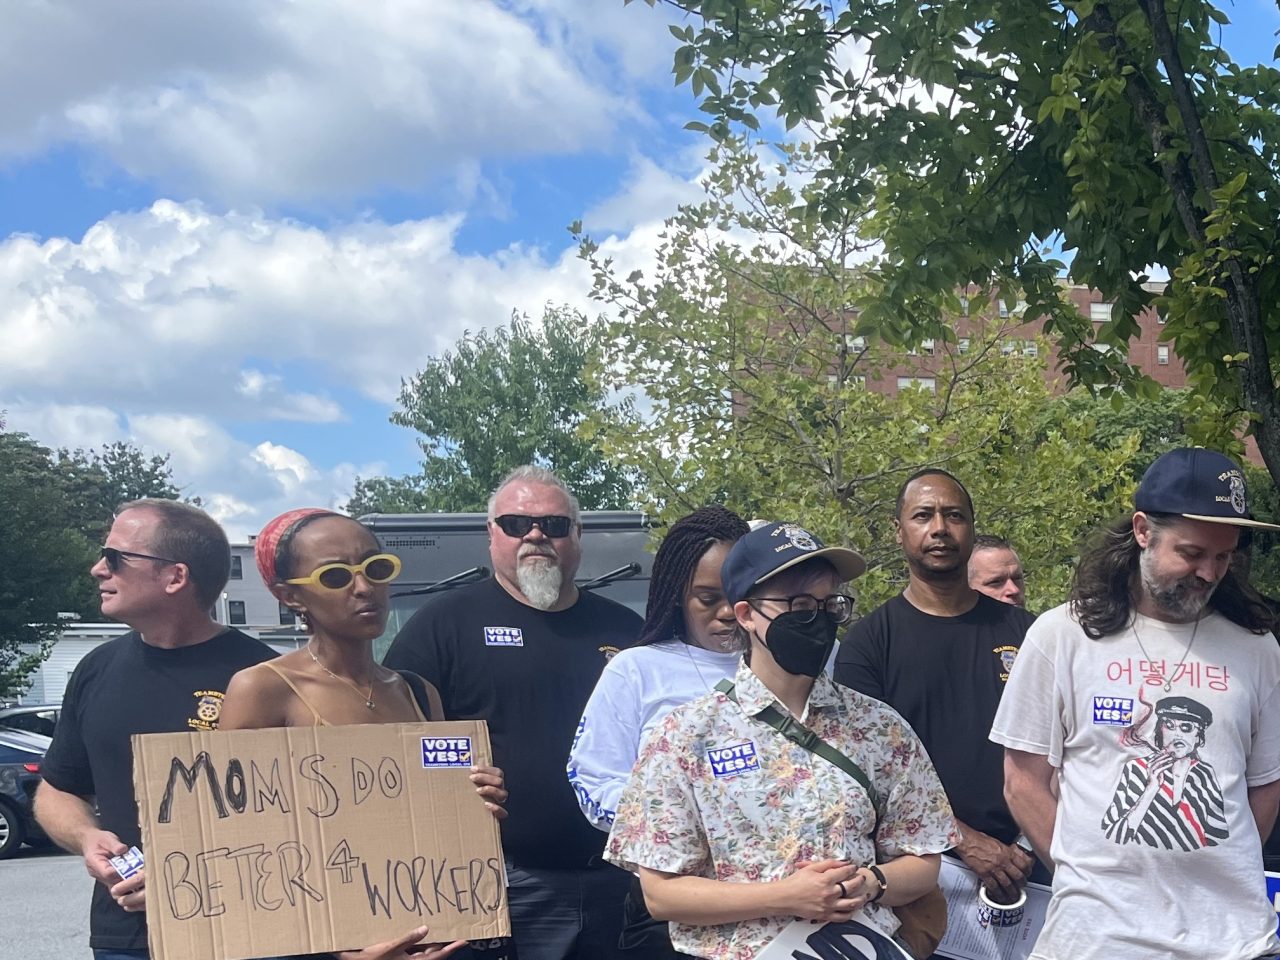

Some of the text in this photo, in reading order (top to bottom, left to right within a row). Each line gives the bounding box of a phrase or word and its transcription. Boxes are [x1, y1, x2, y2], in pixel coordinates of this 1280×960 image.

[1095, 698, 1131, 710] VOTE
[1095, 709, 1120, 721] YES
[424, 739, 468, 750] VOTE
[424, 751, 458, 762] YES
[710, 744, 754, 762] VOTE
[713, 758, 746, 773] YES
[353, 757, 402, 805] DO
[326, 839, 360, 884] 4
[361, 856, 502, 919] WORKERS
